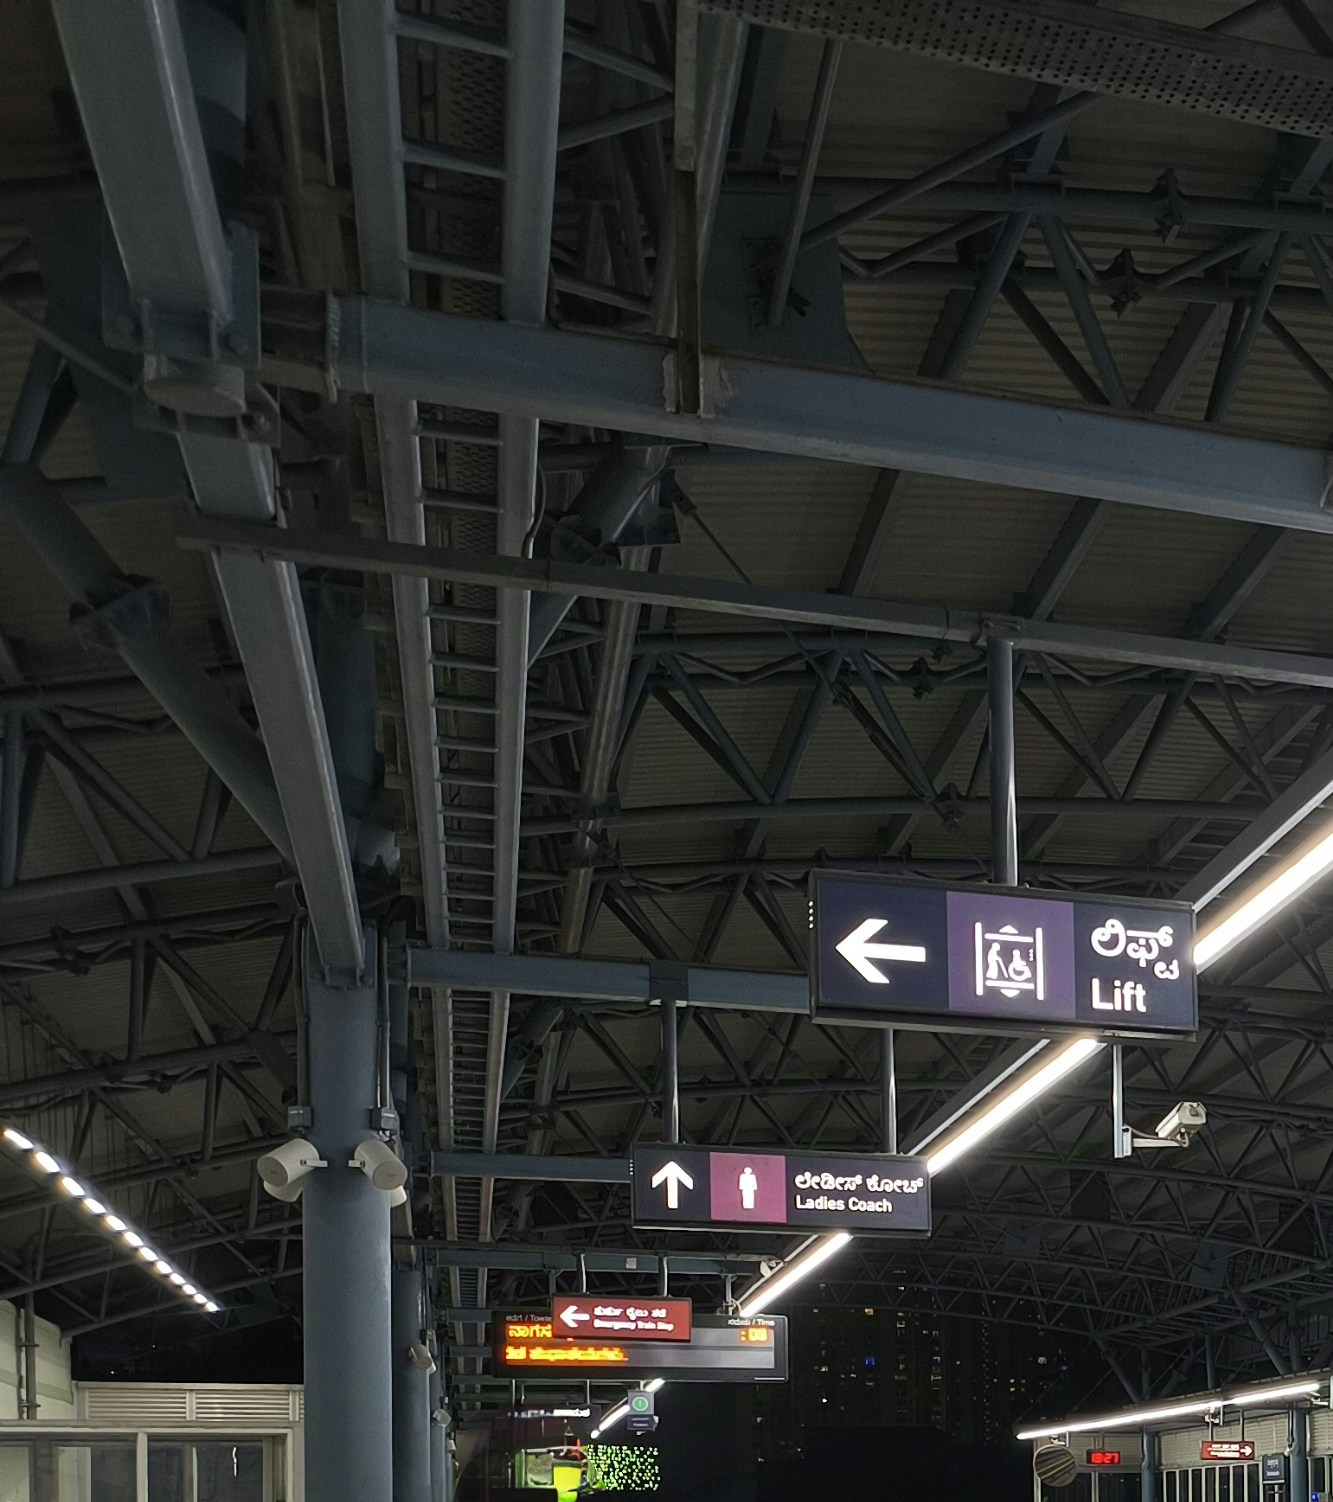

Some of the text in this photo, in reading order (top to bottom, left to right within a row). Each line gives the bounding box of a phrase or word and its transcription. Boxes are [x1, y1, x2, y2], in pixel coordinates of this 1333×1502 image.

[1091, 919, 1179, 980] ಲಿಫ್ಟ್
[1091, 978, 1147, 1012] Lift
[795, 1171, 923, 1194] ಲೇಡೀಸ್ ಕೋಚ್
[795, 1195, 892, 1212] Ladies Coach
[757, 1319, 775, 1327] Time
